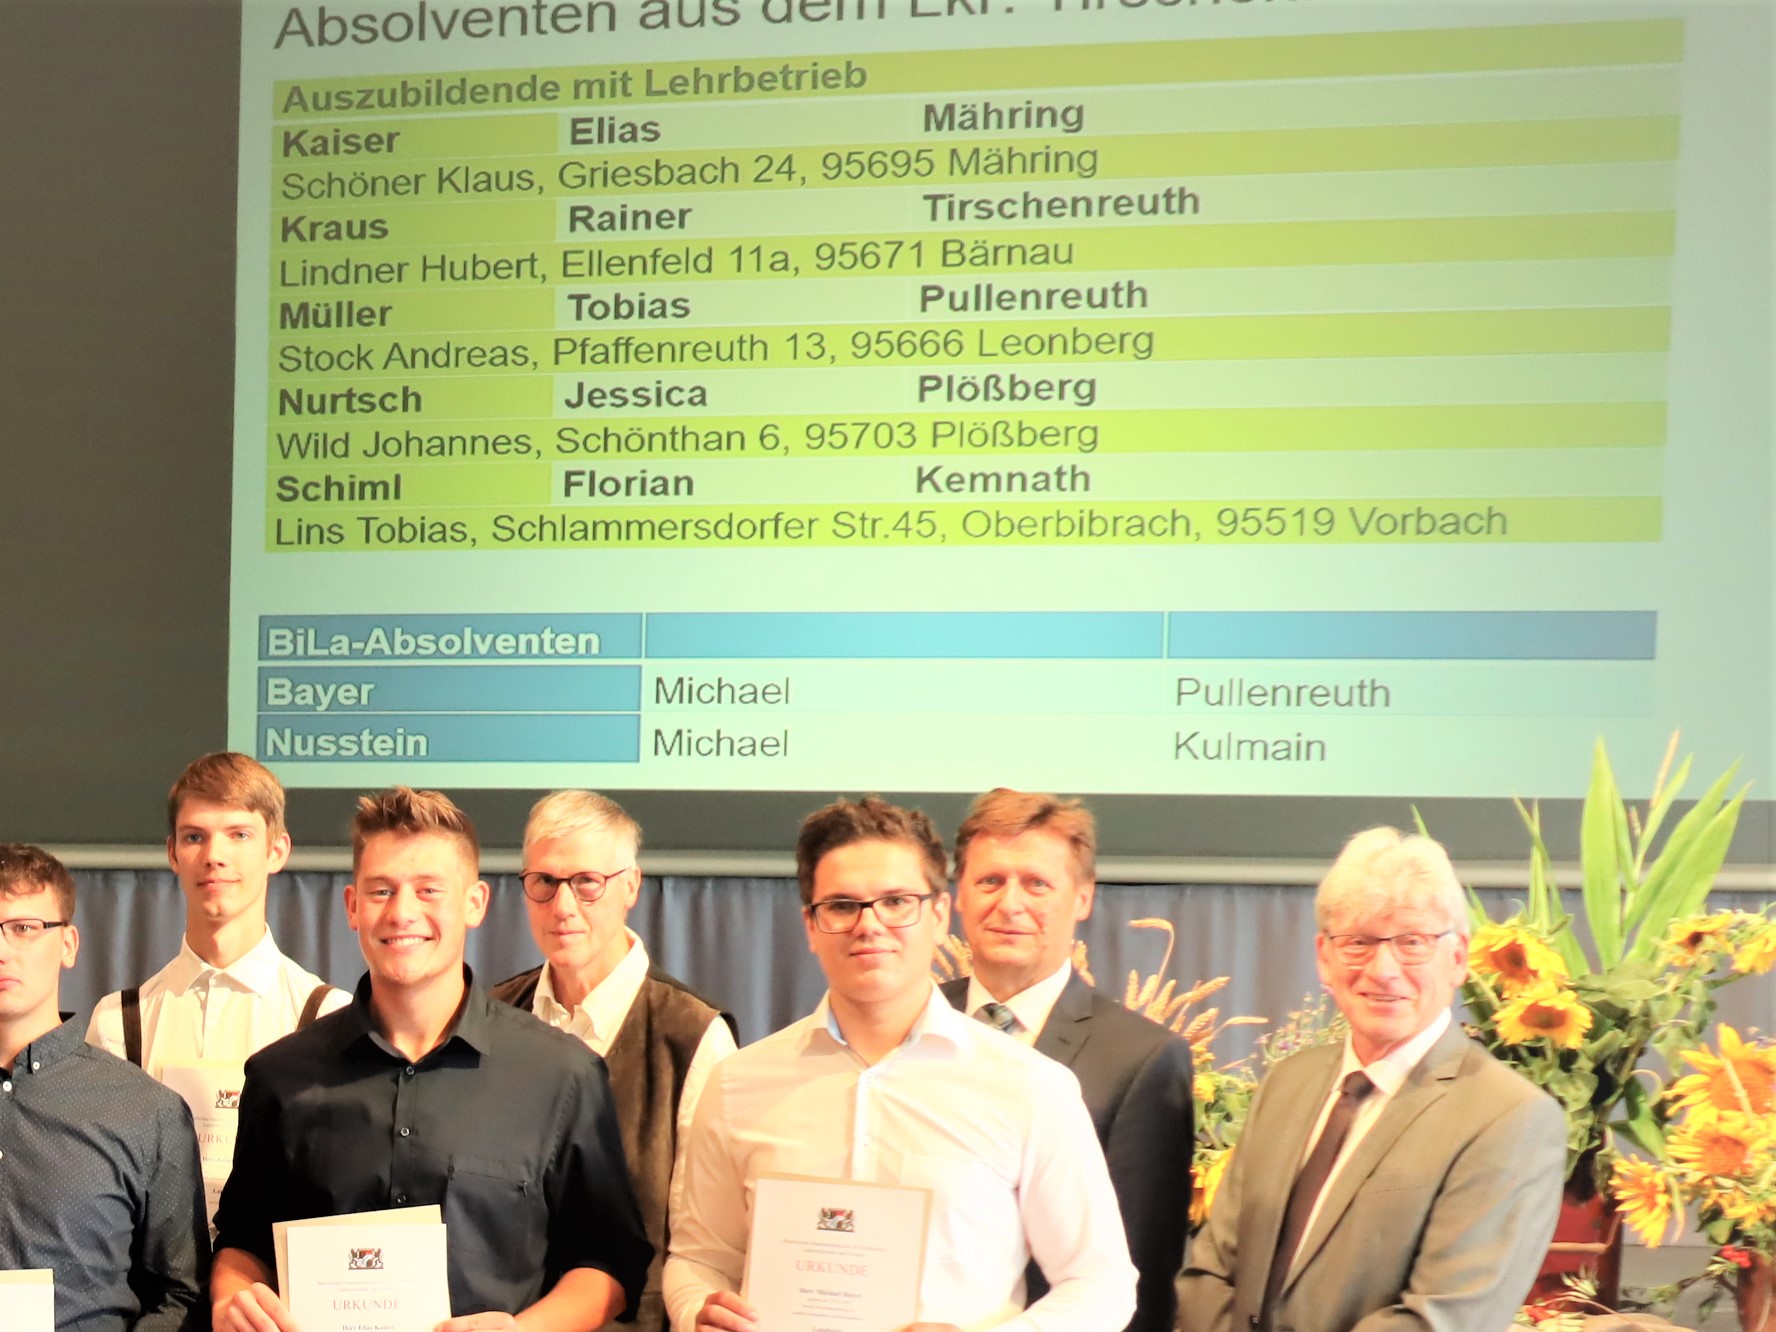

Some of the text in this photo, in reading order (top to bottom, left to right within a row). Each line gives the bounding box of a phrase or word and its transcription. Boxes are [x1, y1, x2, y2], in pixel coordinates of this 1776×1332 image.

[274, 0, 615, 49] Absolventen
[640, 0, 740, 29] aus
[762, 0, 885, 23] dem
[282, 61, 867, 113] Auszubildende mit Lehrbetrieb
[571, 117, 660, 145] Elias
[925, 101, 1083, 133] Mähring
[283, 129, 400, 157] Kaiser
[282, 146, 1097, 200] Schöner Klaus, Griesbach 24, 95695 Mähring
[923, 187, 1198, 221] Tirschenreuth
[282, 216, 388, 243] Kraus
[570, 205, 692, 232] Rainer
[281, 239, 1072, 287] Lindner Hubert, Ellenfeld 11a, 95671 Bärnau
[568, 293, 690, 320] Tobias
[921, 280, 1147, 312] Pullenreuth
[280, 301, 392, 329] Müller
[279, 327, 1153, 372] Stock Andreas, Pfaffenreuth 13, 95666 Leonberg
[279, 386, 421, 415] Nurtsch
[565, 381, 706, 408] Jessica
[919, 374, 1095, 406] Plößberg
[277, 421, 1098, 459] Wild Johannes, Schönthan 6, 95703 Plößberg
[276, 474, 400, 502] Schiml
[565, 470, 693, 497] Florian
[917, 465, 1089, 493] Kemnath
[276, 506, 1507, 547] Lins Tobias, Schlammersdorfer Str.45, Oberbibrach, 95519 Vorbach
[270, 628, 598, 655] BiLa-Absolventen
[269, 679, 374, 711] Bayer
[656, 677, 789, 704] Michael
[1177, 678, 1390, 707] Pullenreuth
[268, 728, 426, 755] Nusstein
[654, 729, 787, 756] Michael
[1175, 732, 1325, 760] Kulmain
[795, 1260, 870, 1276] URKUNDE
[333, 1299, 400, 1311] URKUNDE
